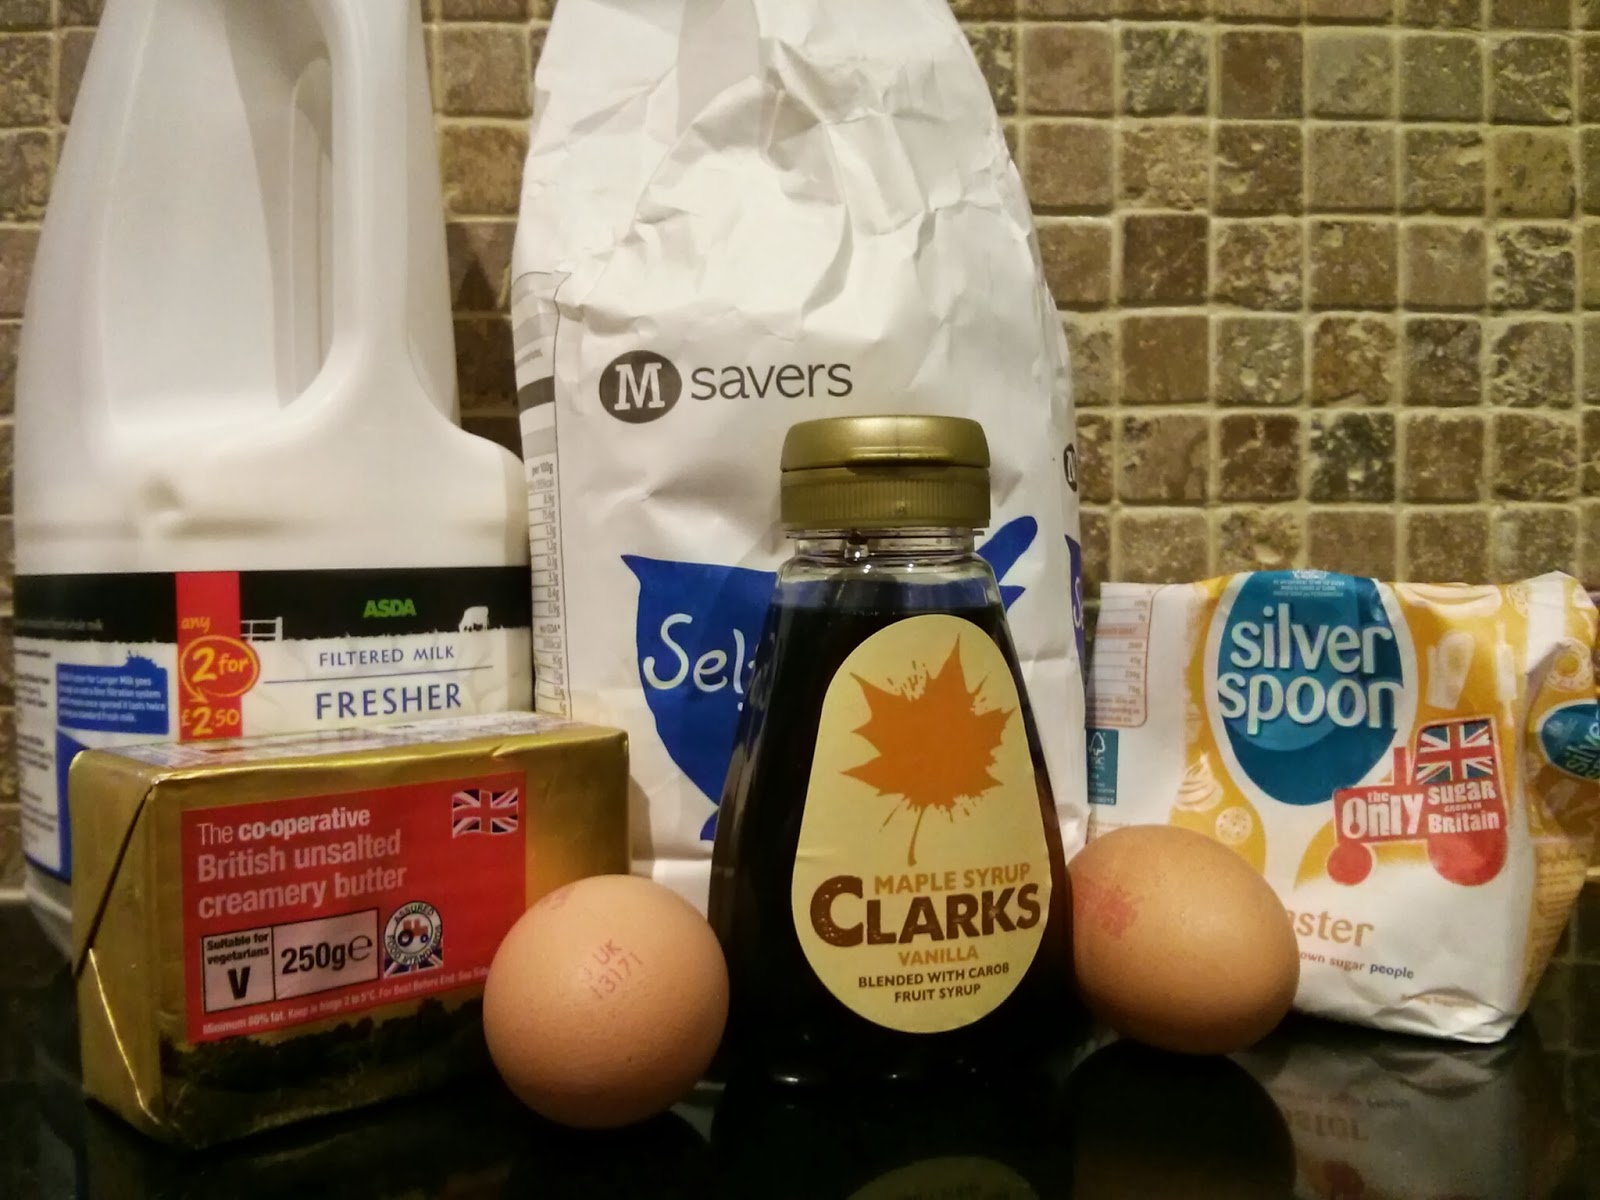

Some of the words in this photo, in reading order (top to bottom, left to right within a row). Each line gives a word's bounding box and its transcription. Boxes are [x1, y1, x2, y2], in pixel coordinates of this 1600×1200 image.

[690, 362, 854, 401] savers
[181, 617, 211, 633] any
[363, 598, 417, 618] ASDA
[1230, 603, 1393, 675] silver
[192, 646, 218, 682] 2
[218, 652, 249, 676] for
[319, 648, 404, 667] FILTERED
[413, 646, 455, 661] MILK
[643, 613, 755, 711] Sel
[315, 682, 462, 720] FRESHER
[1217, 671, 1404, 735] spoon
[197, 822, 233, 846] The
[238, 806, 371, 841] co-operative
[198, 845, 286, 883] British
[294, 828, 401, 870] unsalted
[198, 879, 328, 920] creamery
[334, 866, 408, 899] butter
[874, 871, 957, 896] MAPLE
[963, 862, 1031, 889] SYRUP
[810, 874, 1042, 948] CLARKS
[1286, 908, 1375, 947] ster
[206, 936, 252, 951] Suitable
[253, 932, 270, 944] for
[206, 946, 270, 966] vegetarians
[897, 944, 979, 967] VANILLA
[857, 973, 924, 989] BLENDED
[928, 969, 966, 985] WITH
[968, 962, 1010, 979] CAROB
[1299, 951, 1326, 964] own
[1329, 957, 1365, 972] sugar
[1369, 962, 1415, 980] people
[227, 966, 251, 1000] V
[893, 988, 936, 1004] FRUIT
[938, 983, 982, 1000] SYRUP
[202, 1018, 247, 1035] Minimum
